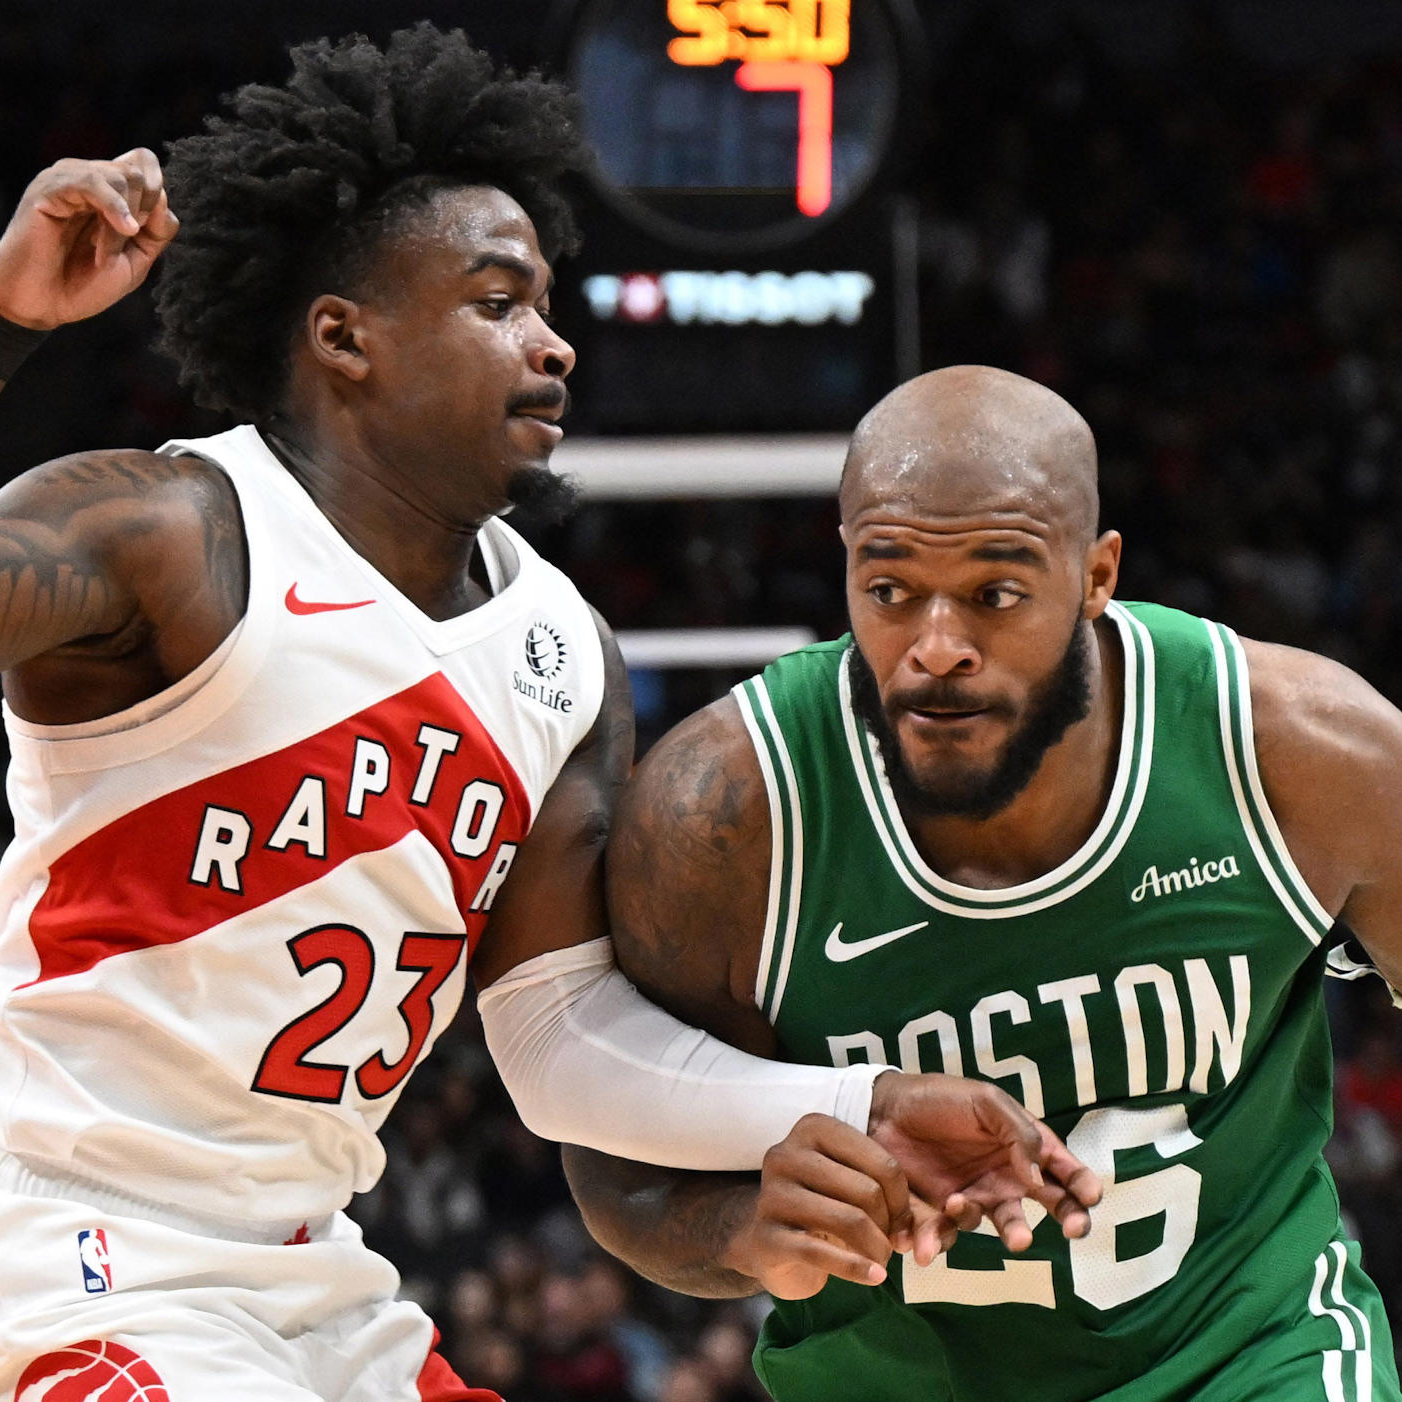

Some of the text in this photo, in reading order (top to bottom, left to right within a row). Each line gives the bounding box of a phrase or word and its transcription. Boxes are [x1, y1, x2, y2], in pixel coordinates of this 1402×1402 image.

[735, 60, 834, 217] 7
[512, 670, 573, 713] Sun Life
[190, 723, 518, 914] RAPTOR
[1131, 855, 1240, 903] Amica
[250, 923, 468, 1105] 23
[826, 955, 1251, 1119] OSTON
